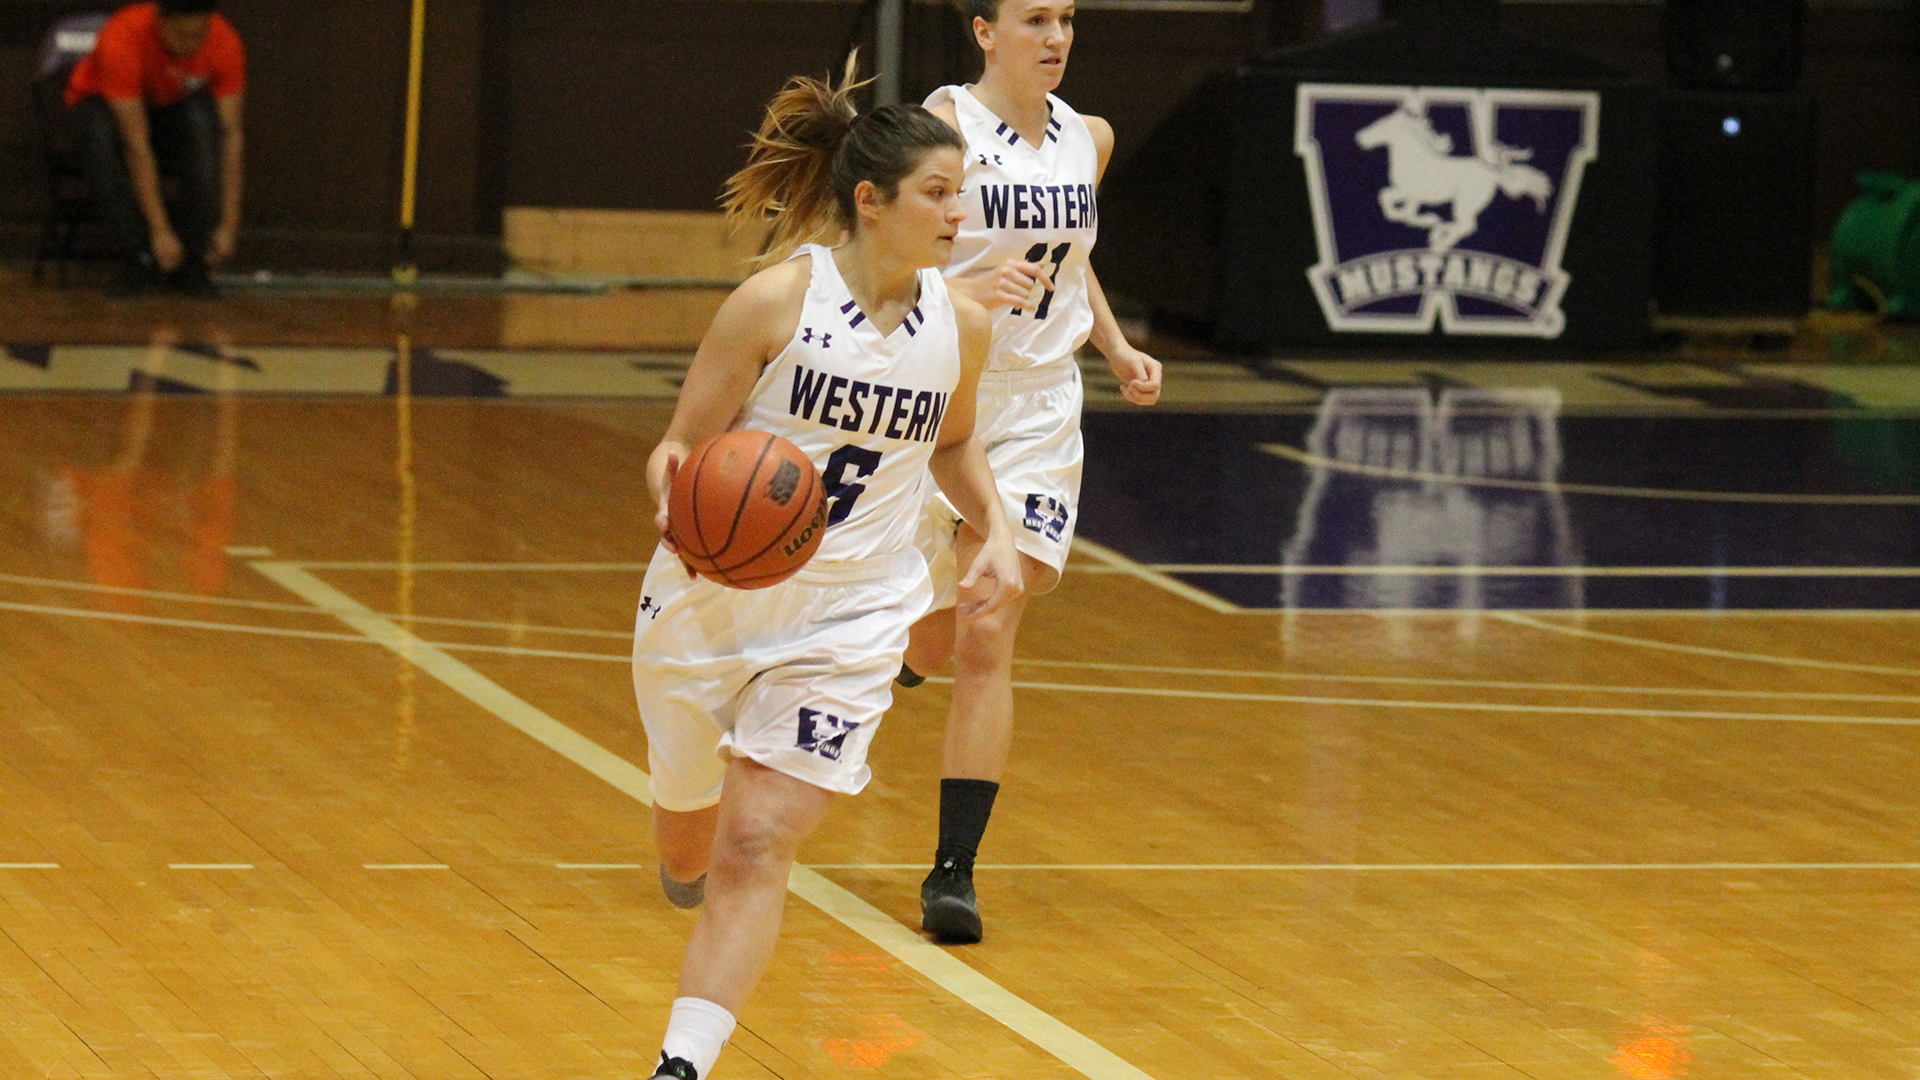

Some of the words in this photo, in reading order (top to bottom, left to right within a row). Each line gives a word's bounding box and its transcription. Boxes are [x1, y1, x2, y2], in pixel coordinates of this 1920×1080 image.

[980, 184, 1096, 229] WESTERN
[1338, 255, 1542, 303] MUSTANGS
[789, 364, 947, 443] WESTERN
